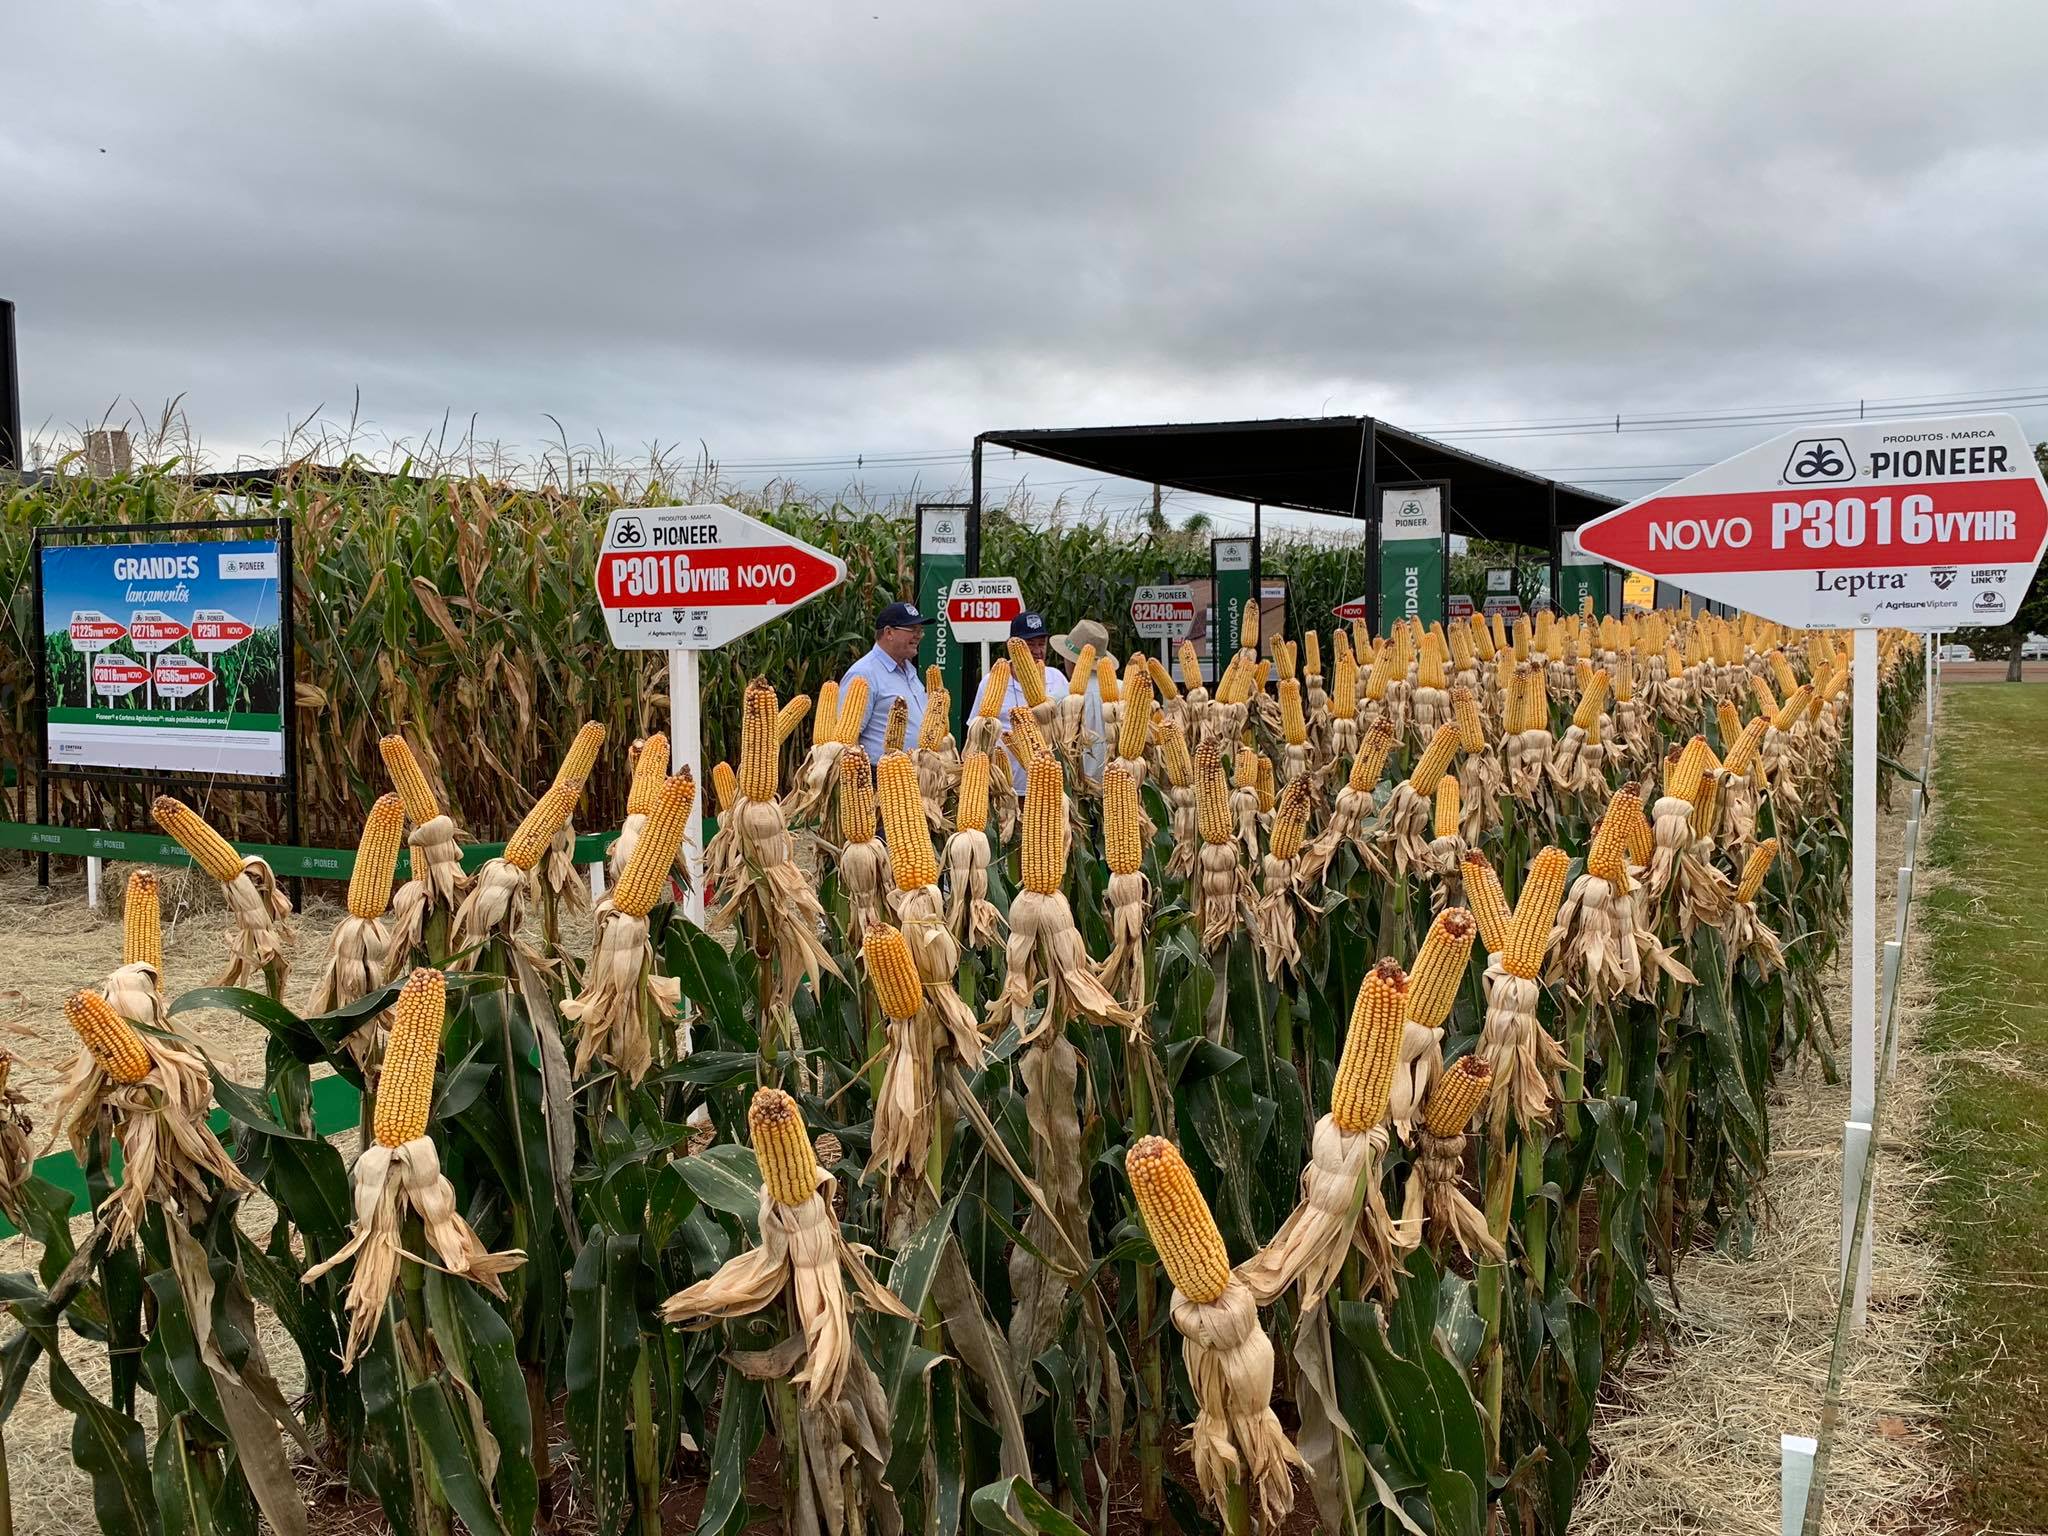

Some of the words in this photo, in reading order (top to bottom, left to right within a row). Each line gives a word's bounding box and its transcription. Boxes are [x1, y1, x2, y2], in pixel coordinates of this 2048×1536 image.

[1882, 433, 1943, 443] PRODUTOS
[1951, 430, 1995, 439] MARCA
[1870, 445, 2008, 479] PIONEER
[1395, 518, 1427, 527] PIONEER
[1648, 517, 1752, 551] NOVO
[1771, 494, 2017, 550] P3016VYHR
[653, 525, 718, 546] PIONEER
[931, 536, 957, 544] PIONEER
[113, 555, 200, 581] GRANDES
[239, 561, 265, 571] PIONEER
[612, 554, 730, 597] P3016VYHR
[737, 563, 796, 588] NOVO
[1971, 569, 2008, 577] LIBERTY
[1816, 570, 1906, 597] Leptra
[125, 582, 191, 606] lançamentos
[978, 585, 1012, 595] PIONEER
[1157, 592, 1187, 600] PIONEER
[960, 601, 1001, 619] P1630
[619, 608, 662, 628] Leptra
[1228, 597, 1239, 649] INOVAÇÃO
[103, 627, 119, 635] NOVO
[164, 627, 180, 635] NOVO
[227, 627, 243, 635] NOVO
[936, 586, 948, 670] TECNOLOGIA
[127, 671, 143, 679] NOVO
[190, 672, 206, 680] NOVO
[40, 834, 61, 843] PIONEER
[103, 839, 125, 849] PIONEER
[170, 846, 189, 856] PIONE
[313, 858, 339, 868] PIONEER
